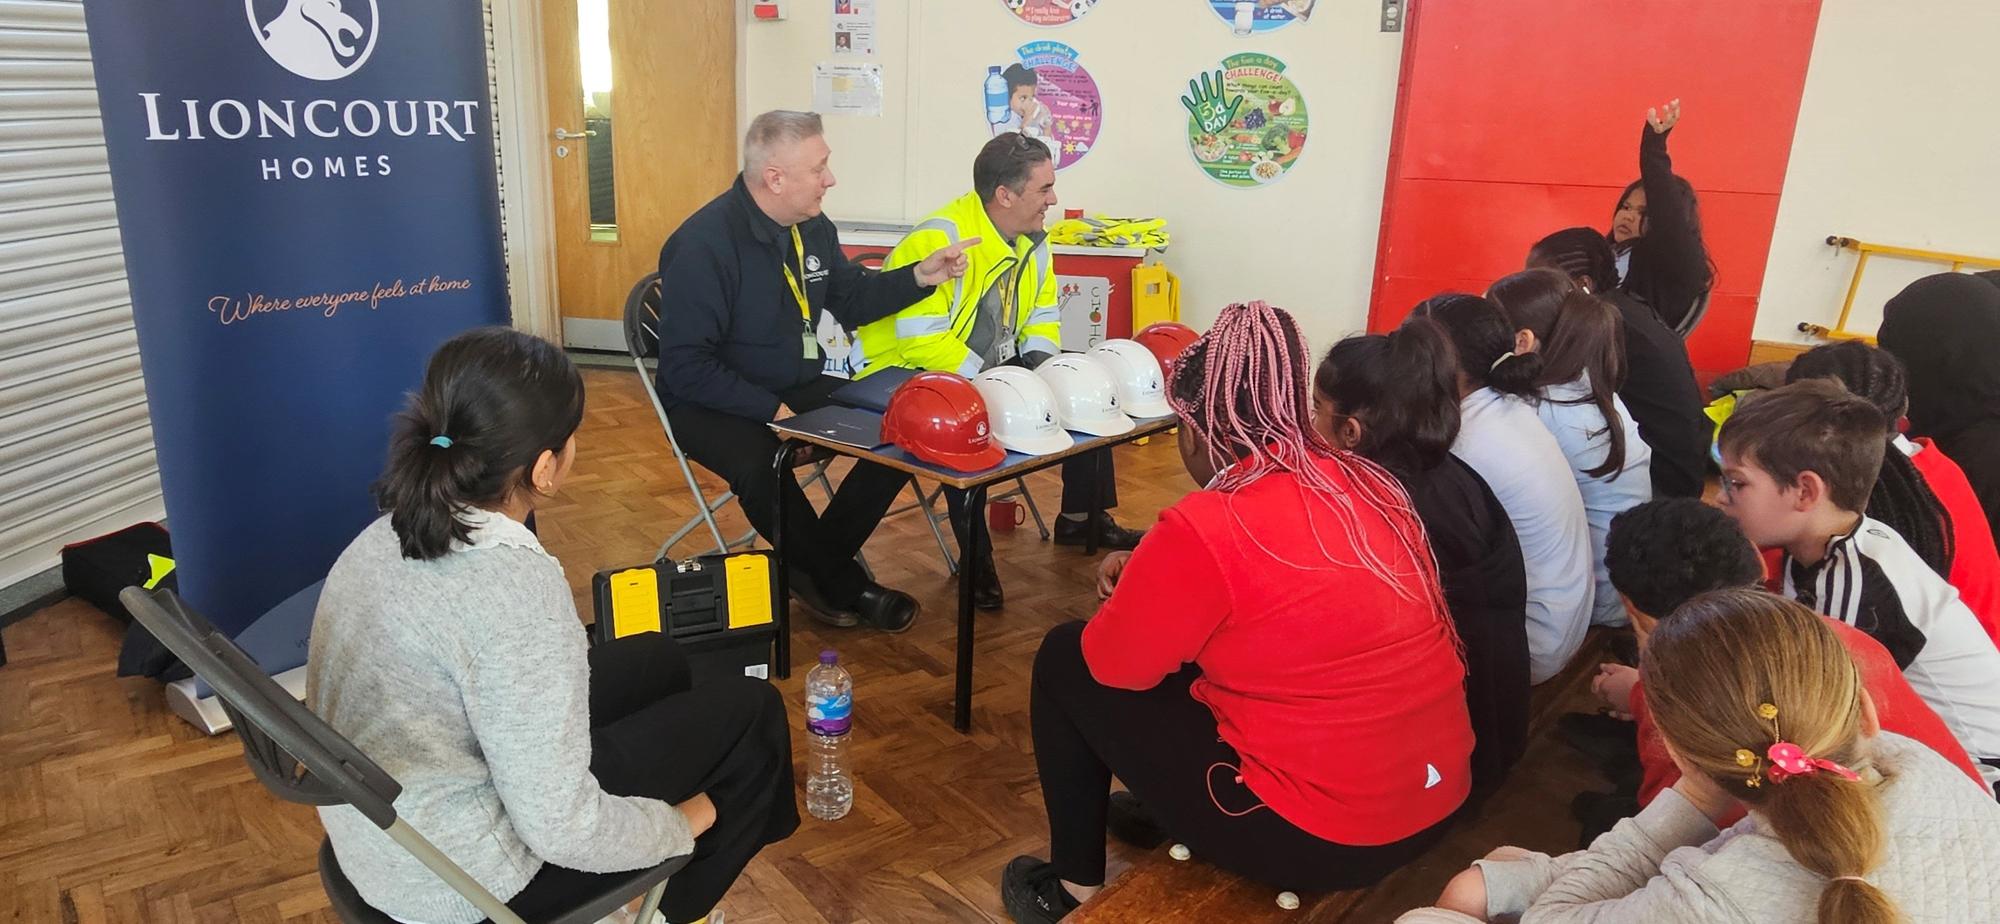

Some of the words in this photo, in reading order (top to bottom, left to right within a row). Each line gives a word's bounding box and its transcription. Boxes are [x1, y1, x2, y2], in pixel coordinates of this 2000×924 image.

[1224, 68, 1283, 84] CHALLENGE!
[138, 92, 479, 141] LIONCOURT
[1200, 103, 1215, 120] 5
[1204, 115, 1227, 131] DAY
[261, 154, 392, 181] HOMES
[208, 293, 291, 325] Where
[295, 290, 370, 318] everyone
[371, 279, 406, 310] feels
[409, 278, 426, 295] at
[428, 275, 471, 293] home
